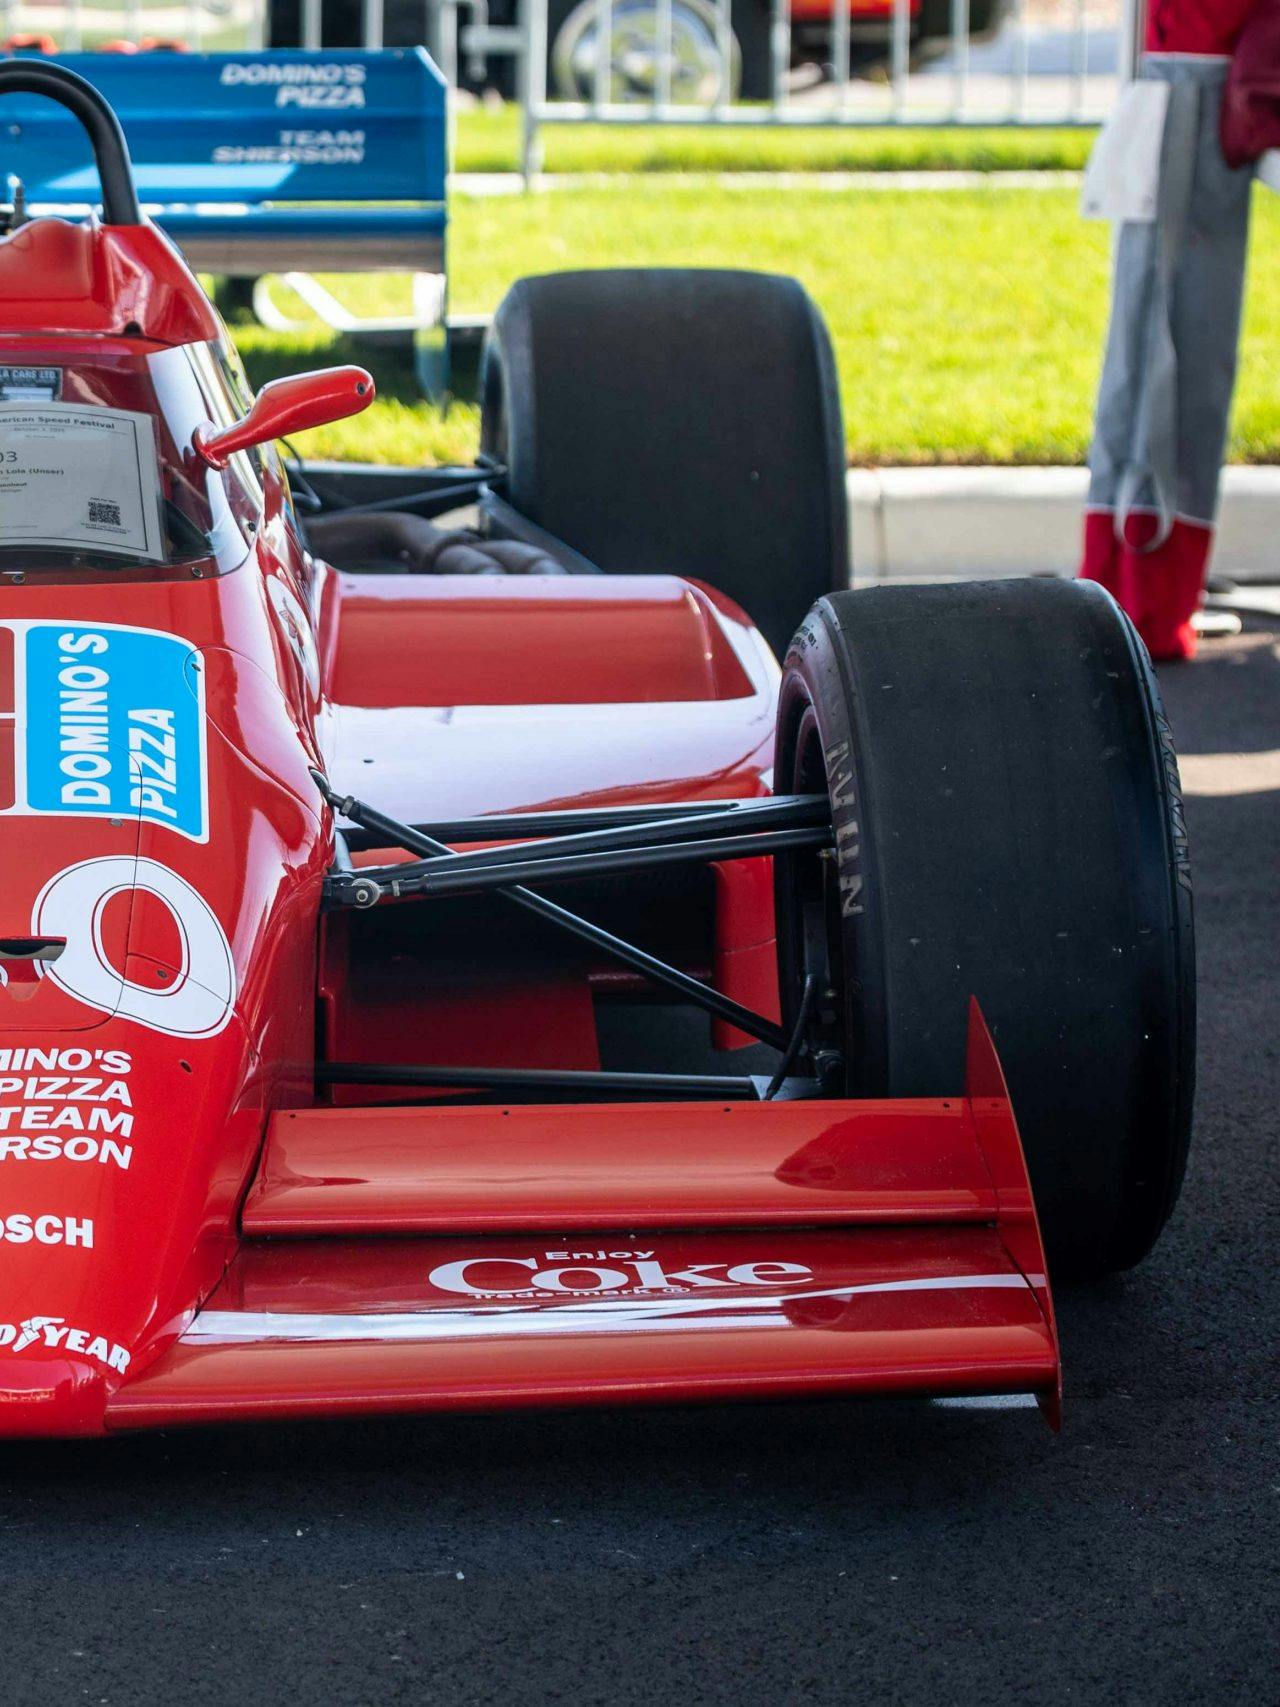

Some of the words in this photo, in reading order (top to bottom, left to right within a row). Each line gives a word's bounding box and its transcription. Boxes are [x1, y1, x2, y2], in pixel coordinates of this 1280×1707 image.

[275, 85, 366, 109] PIZZA
[279, 129, 366, 145] TEAM
[38, 416, 70, 425] Speed
[74, 419, 115, 430] Festival
[58, 632, 112, 805] DOMINO'S
[128, 708, 177, 818] PIZZA
[545, 1250, 655, 1260] Enjoy
[428, 1257, 814, 1295] Coke
